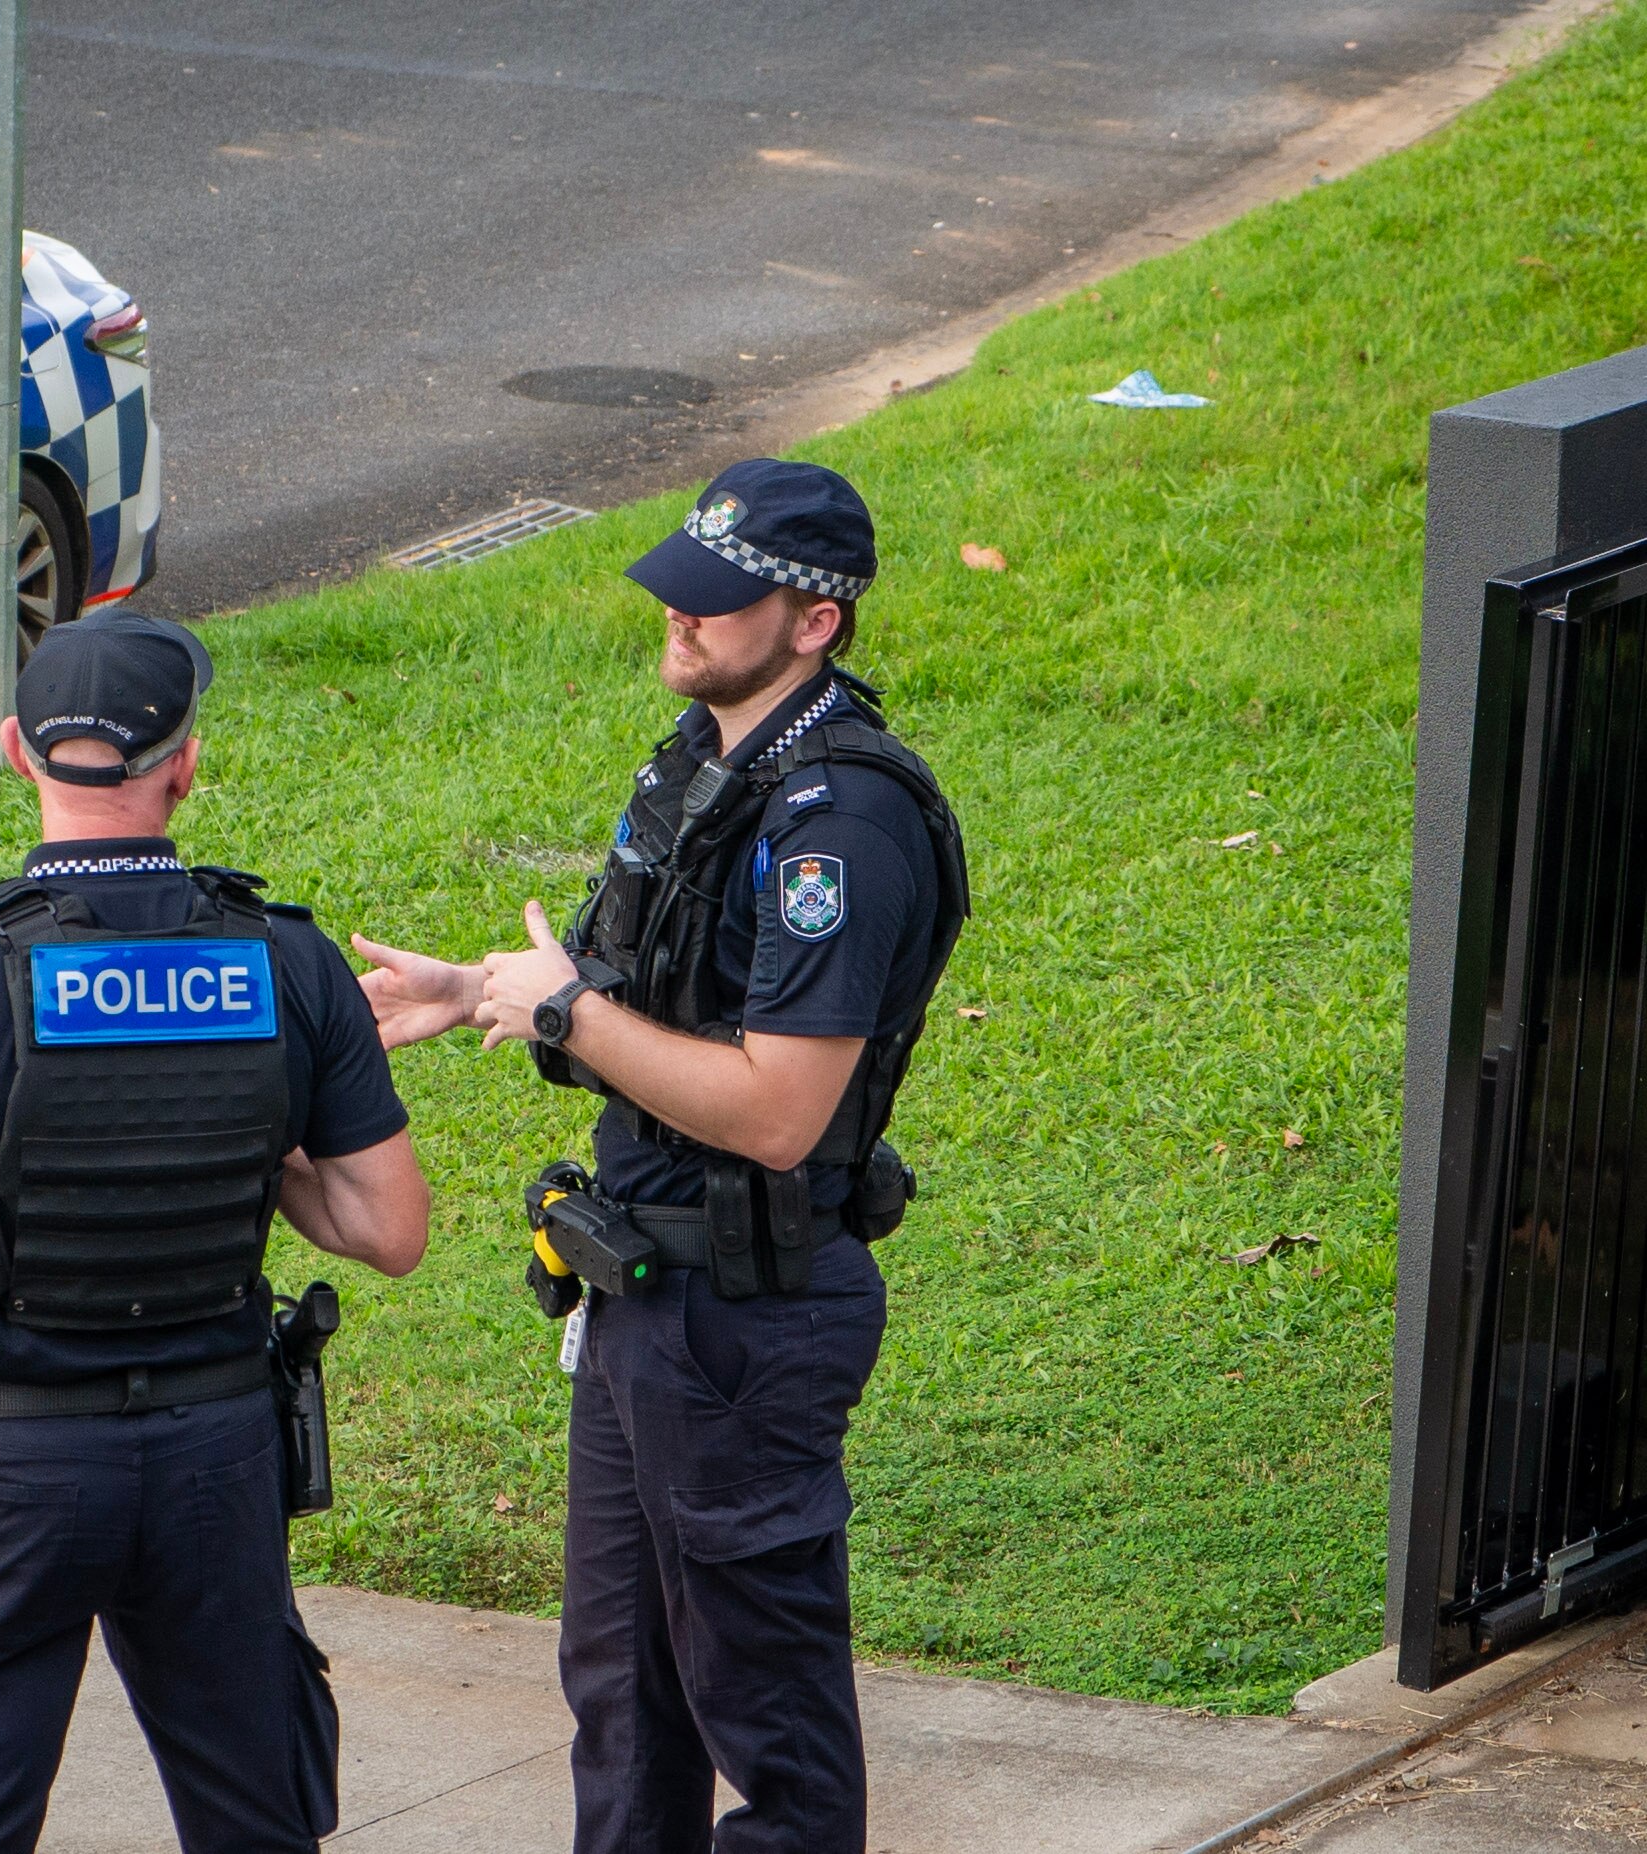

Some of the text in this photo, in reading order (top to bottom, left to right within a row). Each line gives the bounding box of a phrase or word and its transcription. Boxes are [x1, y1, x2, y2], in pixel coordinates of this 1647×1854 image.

[35, 715, 133, 741] QUEENSLAND POLICE
[98, 857, 136, 873] QPS
[55, 966, 252, 1015] POLICE
